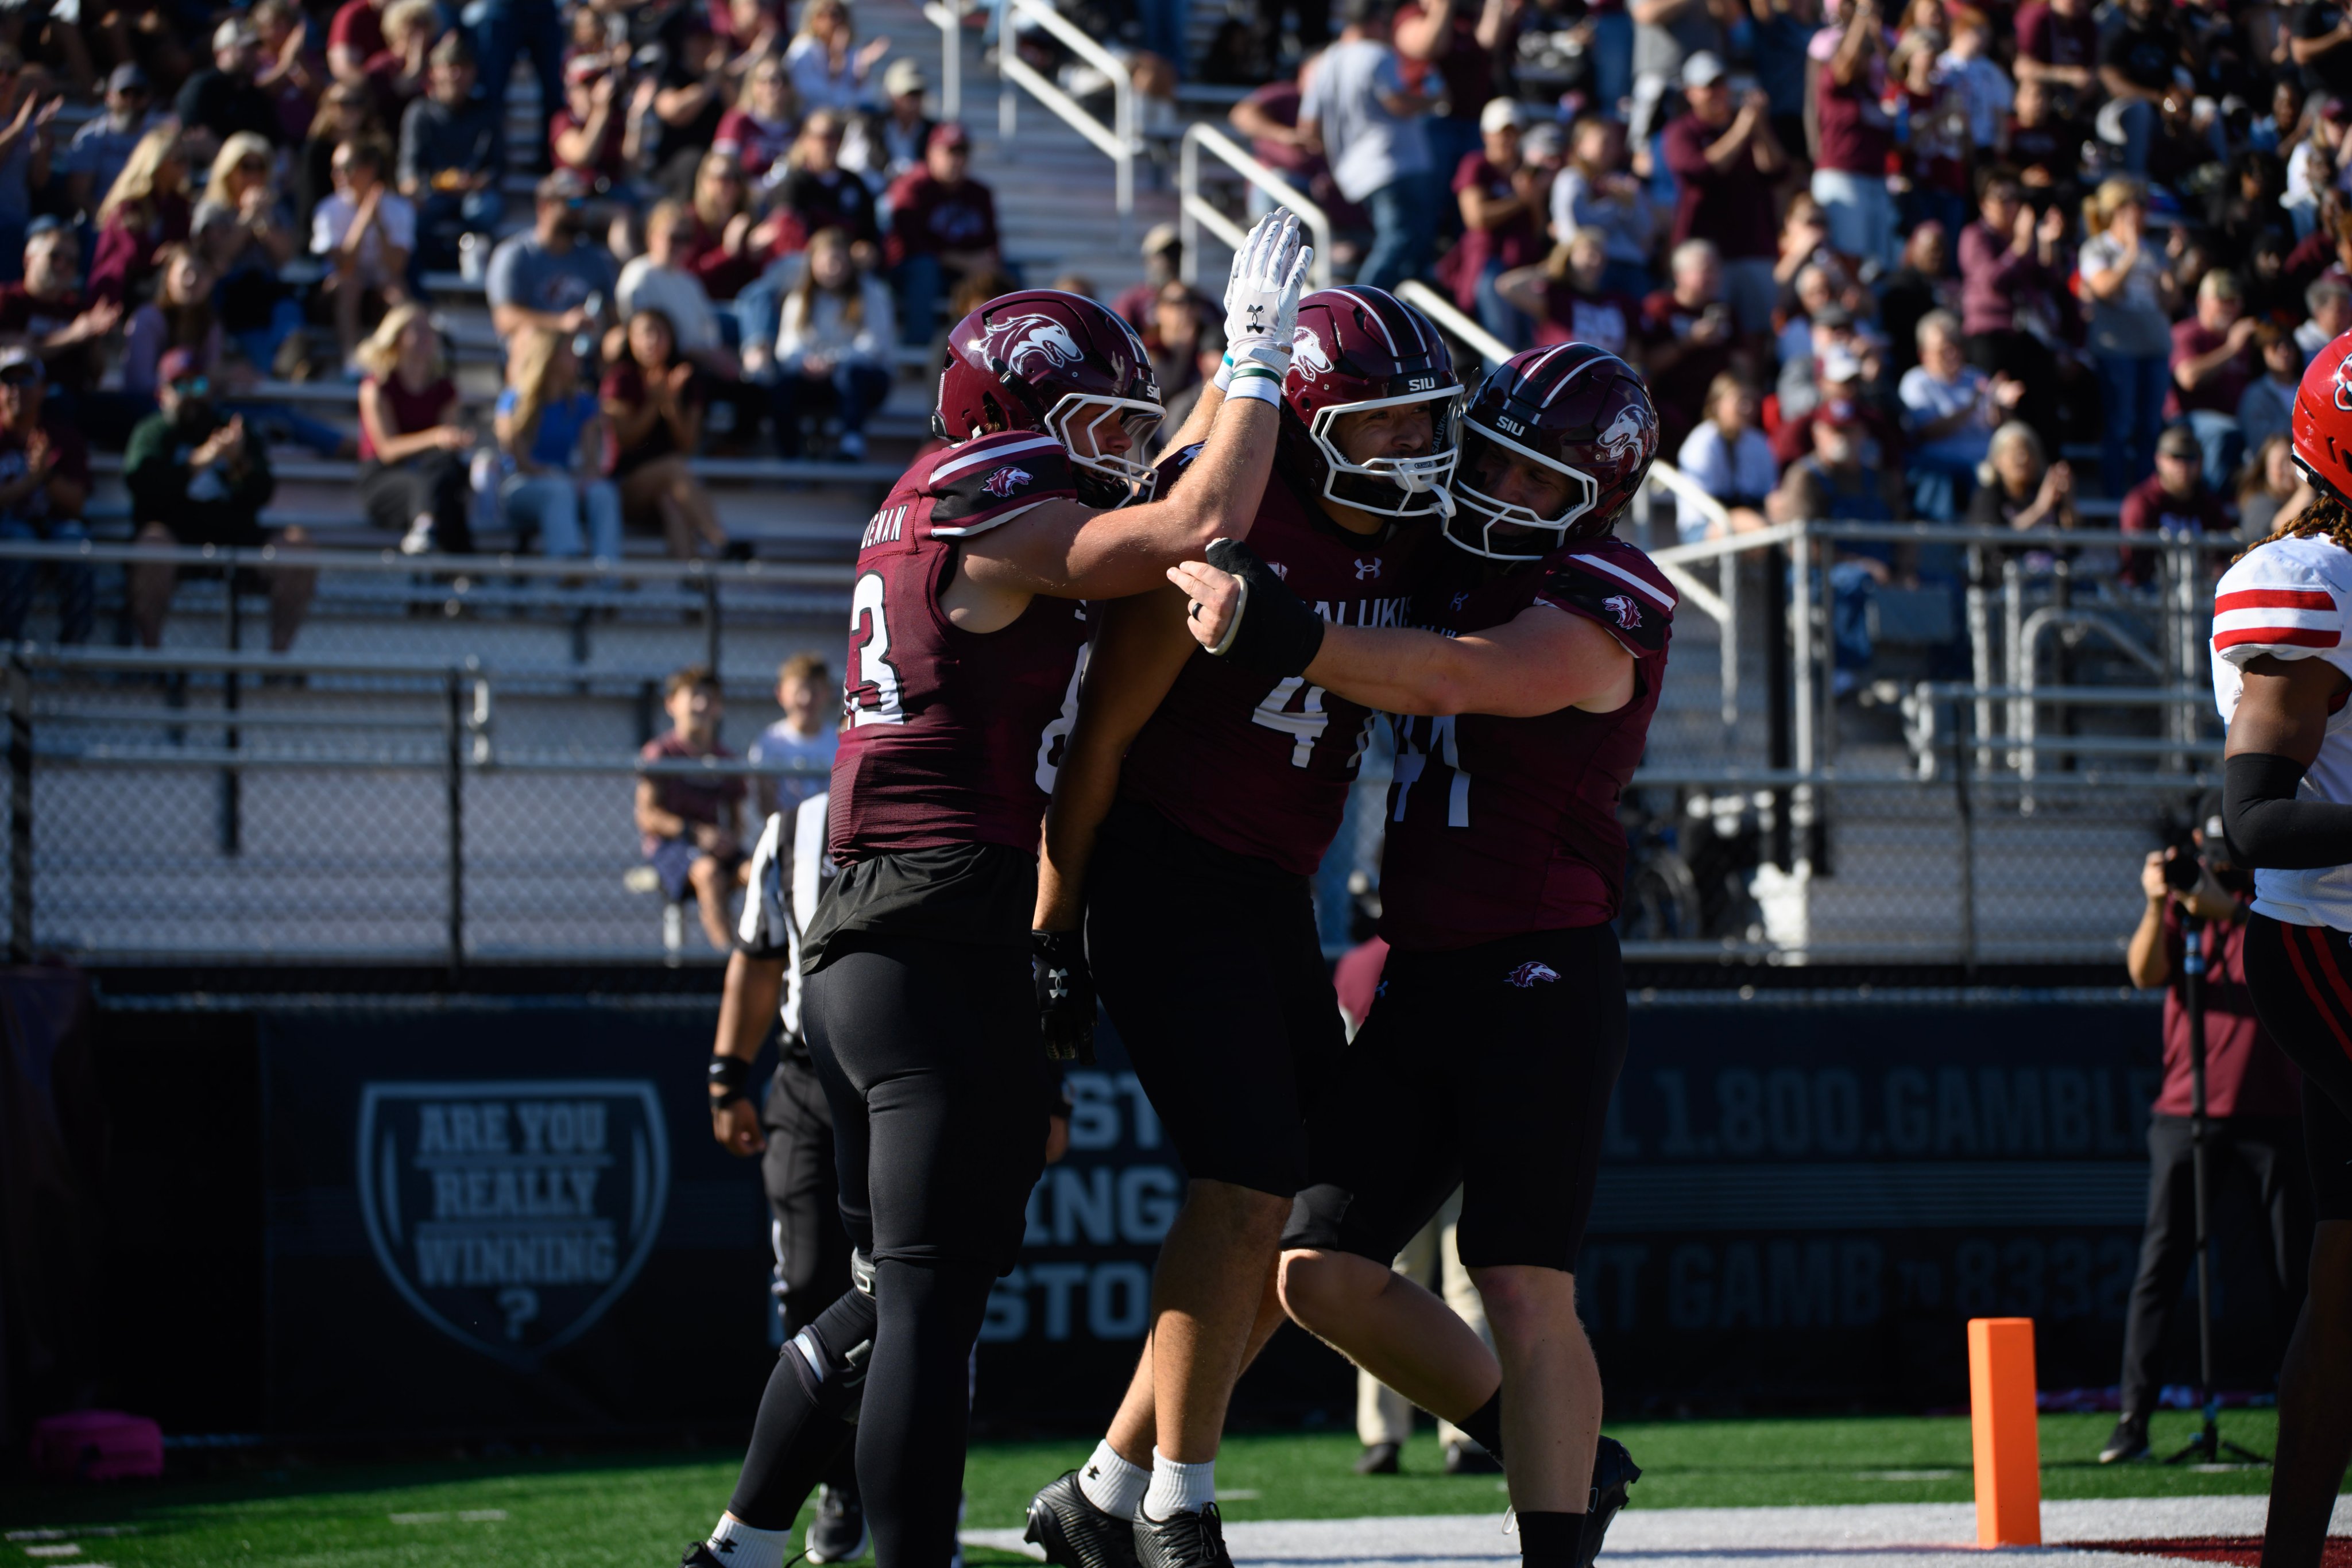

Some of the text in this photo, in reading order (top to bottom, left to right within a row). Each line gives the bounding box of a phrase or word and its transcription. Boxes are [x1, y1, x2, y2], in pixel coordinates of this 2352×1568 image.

[1409, 377, 1436, 392] SIU
[1496, 415, 1526, 436] SIU
[1314, 595, 1414, 629] ALUKIS
[844, 569, 908, 728] 3
[418, 1101, 608, 1153] ARE YOU
[430, 1169, 602, 1219] REALLY
[413, 1234, 620, 1288] WINNING
[1666, 1238, 1887, 1331] GAMB
[494, 1287, 542, 1344] ?
